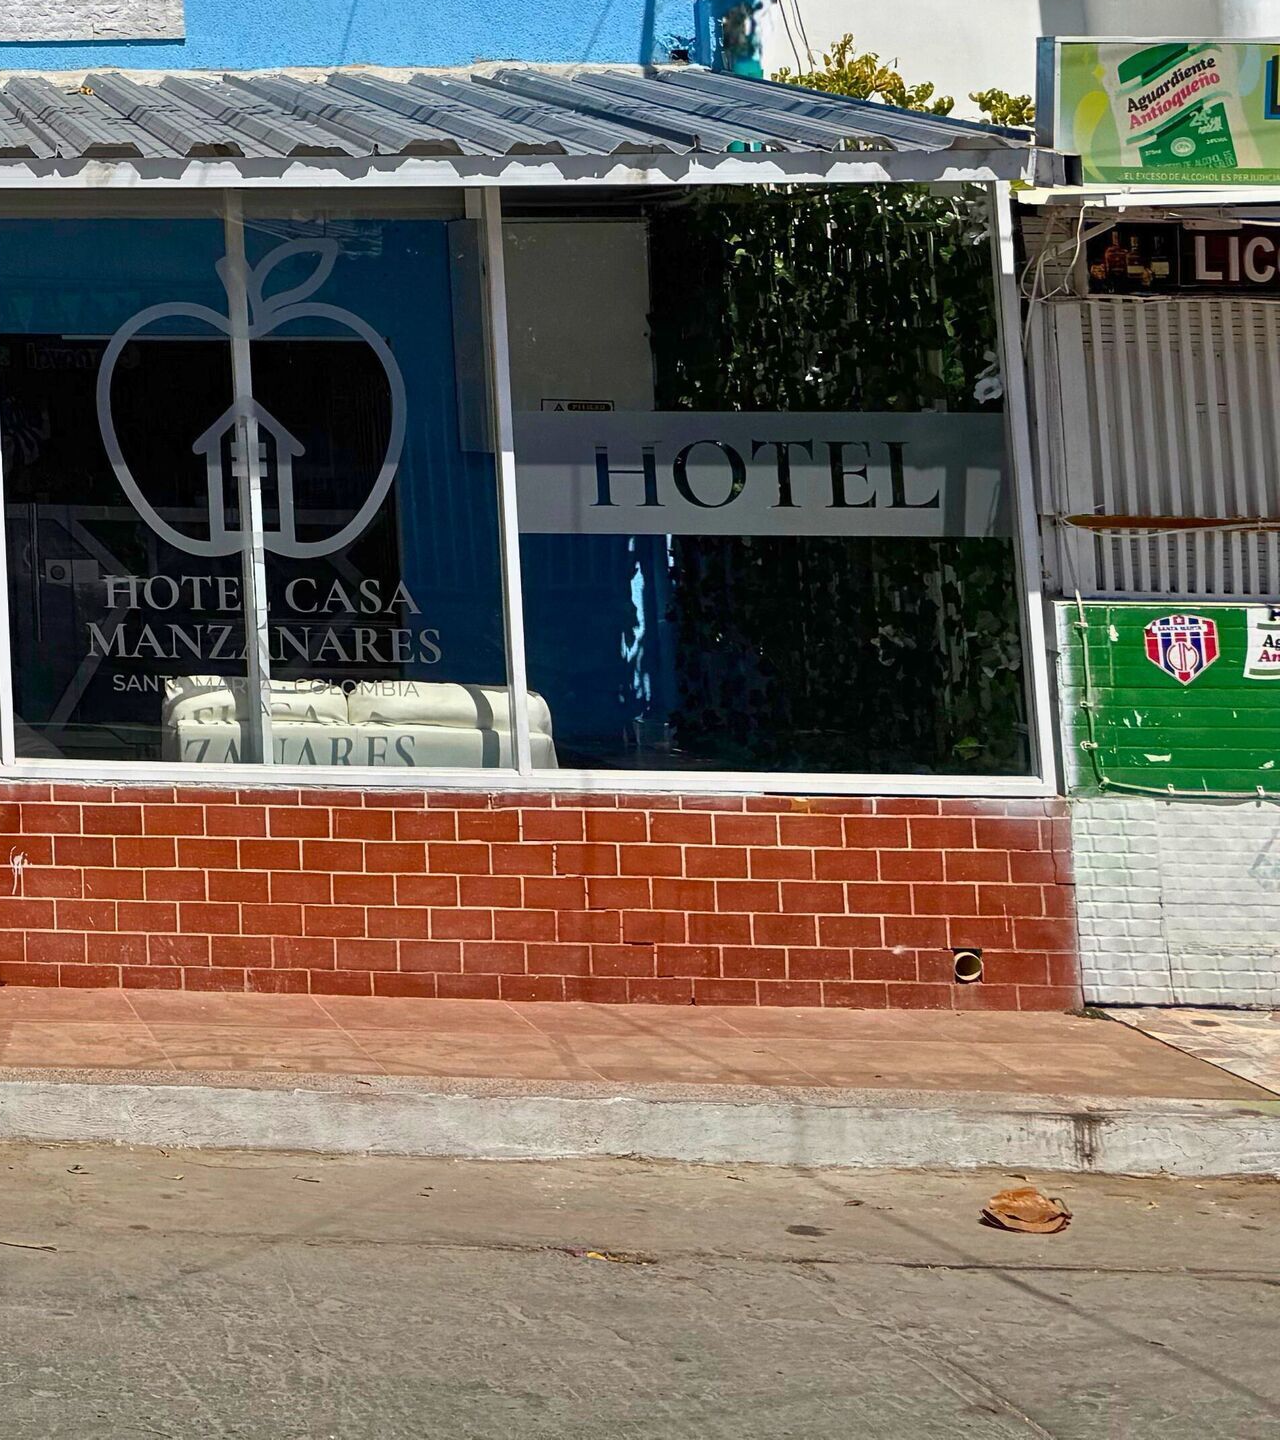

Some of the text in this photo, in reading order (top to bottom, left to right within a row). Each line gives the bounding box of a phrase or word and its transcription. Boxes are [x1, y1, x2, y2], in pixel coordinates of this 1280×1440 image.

[1127, 57, 1217, 113] Aguardiente
[1129, 72, 1221, 130] Antioqueño
[1136, 172, 1167, 181] EXCESO
[1169, 173, 1179, 181] DE
[1181, 173, 1218, 182] ALCOHOL
[1221, 173, 1231, 182] ES
[1195, 235, 1280, 283] LIC
[590, 438, 940, 509] HOTEL
[102, 574, 423, 615] HOTE CASA
[86, 622, 442, 665] MANZANARES
[113, 673, 184, 693] SANT
[294, 678, 420, 698] COLOMBIA
